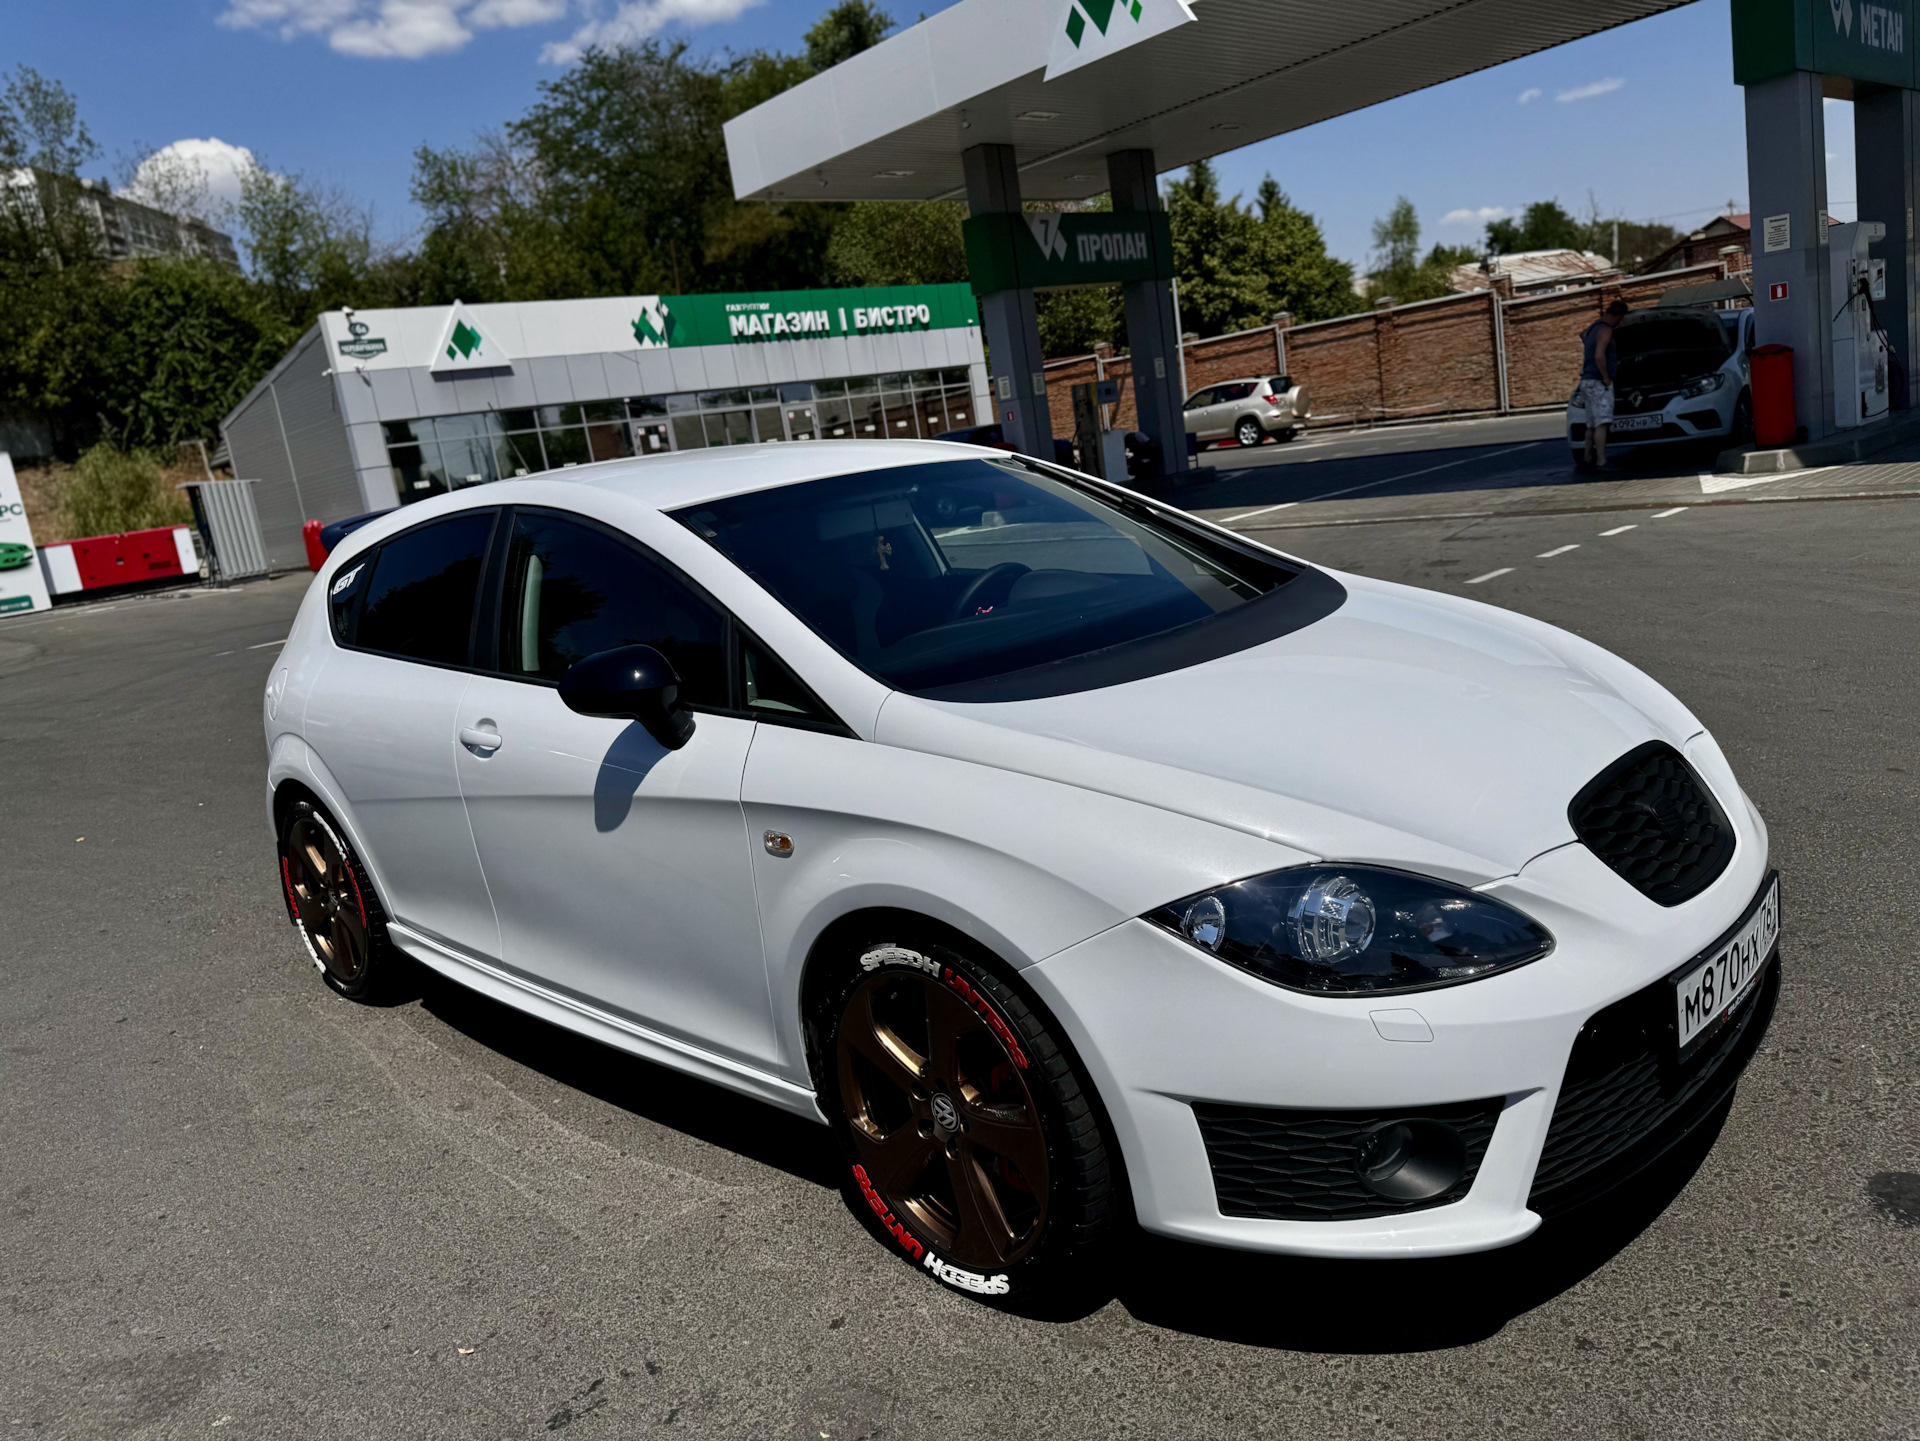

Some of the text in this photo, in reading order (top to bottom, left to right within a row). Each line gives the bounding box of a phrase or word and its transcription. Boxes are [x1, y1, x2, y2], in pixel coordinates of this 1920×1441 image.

[1860, 2, 1903, 53] МЕТАН
[1039, 220, 1050, 246] 7
[1076, 232, 1148, 262] ПРОПАН
[728, 304, 931, 337] МАГАЗИН БИСТРО
[1684, 925, 1760, 1035] М870НХ
